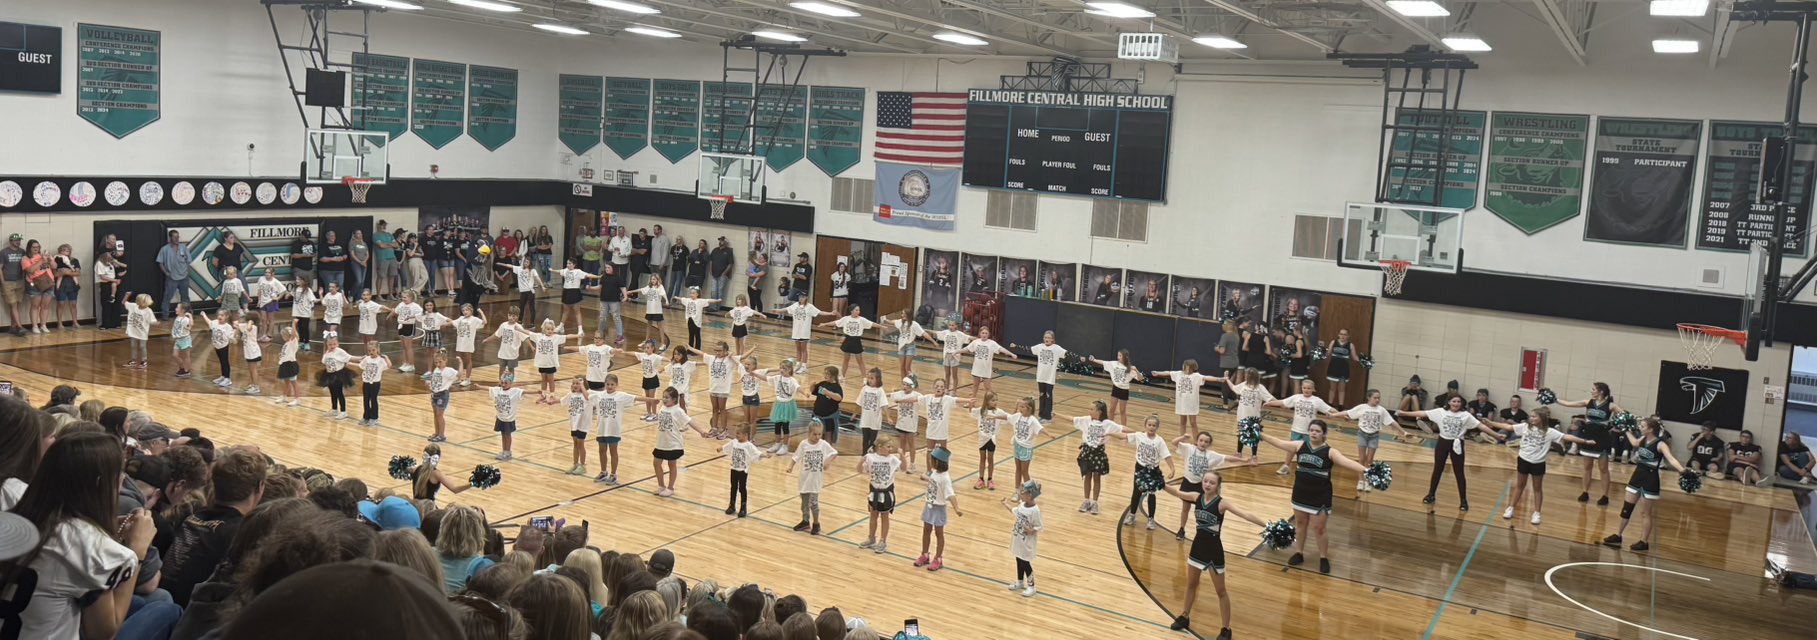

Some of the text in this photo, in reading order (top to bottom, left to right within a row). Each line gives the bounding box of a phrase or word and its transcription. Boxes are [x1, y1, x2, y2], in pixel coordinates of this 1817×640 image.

[87, 29, 153, 44] VOLLEYBALL
[18, 52, 52, 64] GUEST
[969, 89, 1168, 109] FILLMORE CENTRAL HIGH SCHOOL
[1504, 117, 1576, 130] WRESTLING
[1017, 128, 1039, 138] HOME
[1084, 132, 1111, 143] GUEST
[1051, 135, 1071, 143] PERIOD
[1632, 138, 1662, 146] STATE
[1615, 144, 1677, 154] TOURNAMENT
[1009, 158, 1026, 166] FOULS
[1042, 160, 1077, 169] PLAYER FOUL
[1634, 158, 1688, 168] PARTICIPANT
[1093, 164, 1111, 172] FOULS
[1008, 181, 1024, 190] SCORE
[1048, 184, 1067, 192] MATCH
[1529, 186, 1567, 194] CHAMPIONS
[1091, 188, 1110, 196] SCORE
[1709, 201, 1730, 209] 2007
[1750, 203, 1767, 211] 3RD
[1708, 211, 1729, 219] 2008
[1708, 219, 1727, 227] 2018
[1705, 235, 1724, 243] 2021
